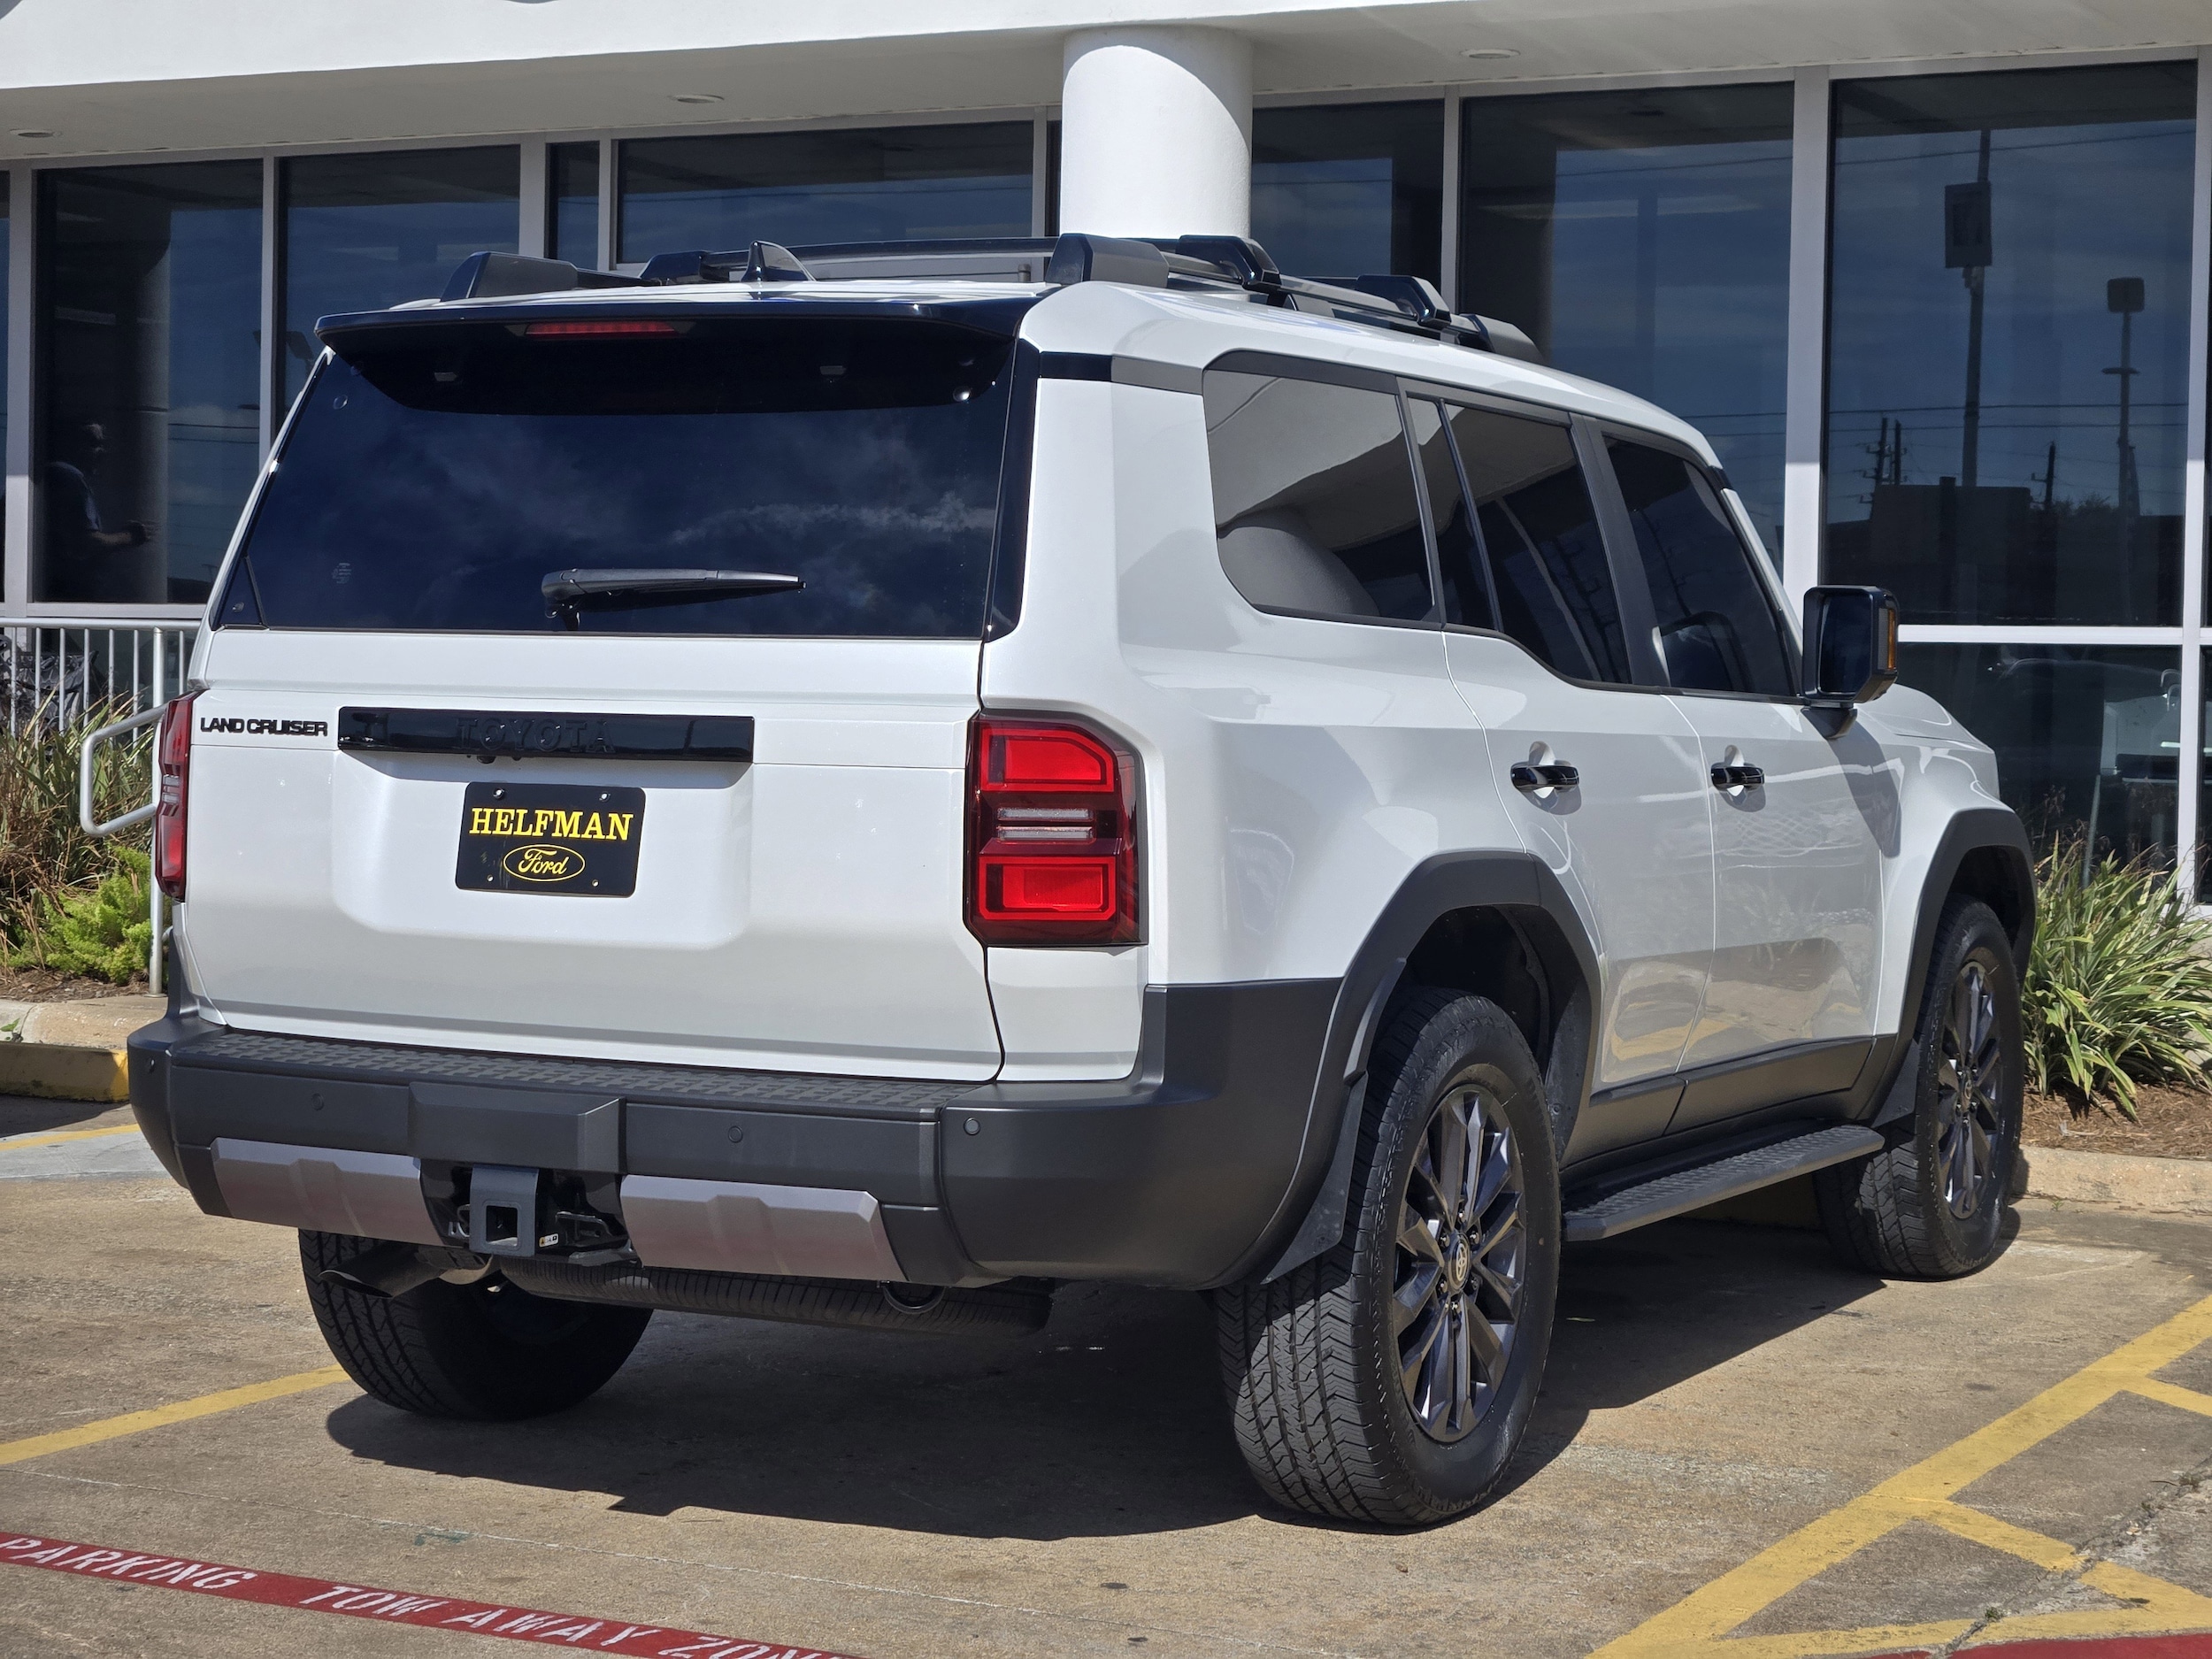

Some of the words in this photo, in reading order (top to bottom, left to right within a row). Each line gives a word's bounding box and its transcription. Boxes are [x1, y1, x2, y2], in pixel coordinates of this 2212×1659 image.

[200, 717, 244, 733] LAND
[247, 718, 328, 737] CRUISER
[456, 717, 617, 753] TOYOTA
[469, 807, 634, 841] HELFMAN
[518, 848, 570, 875] Ford
[0, 1537, 257, 1590] PARKING
[299, 1586, 449, 1617] TOW
[441, 1609, 663, 1647] AWAY
